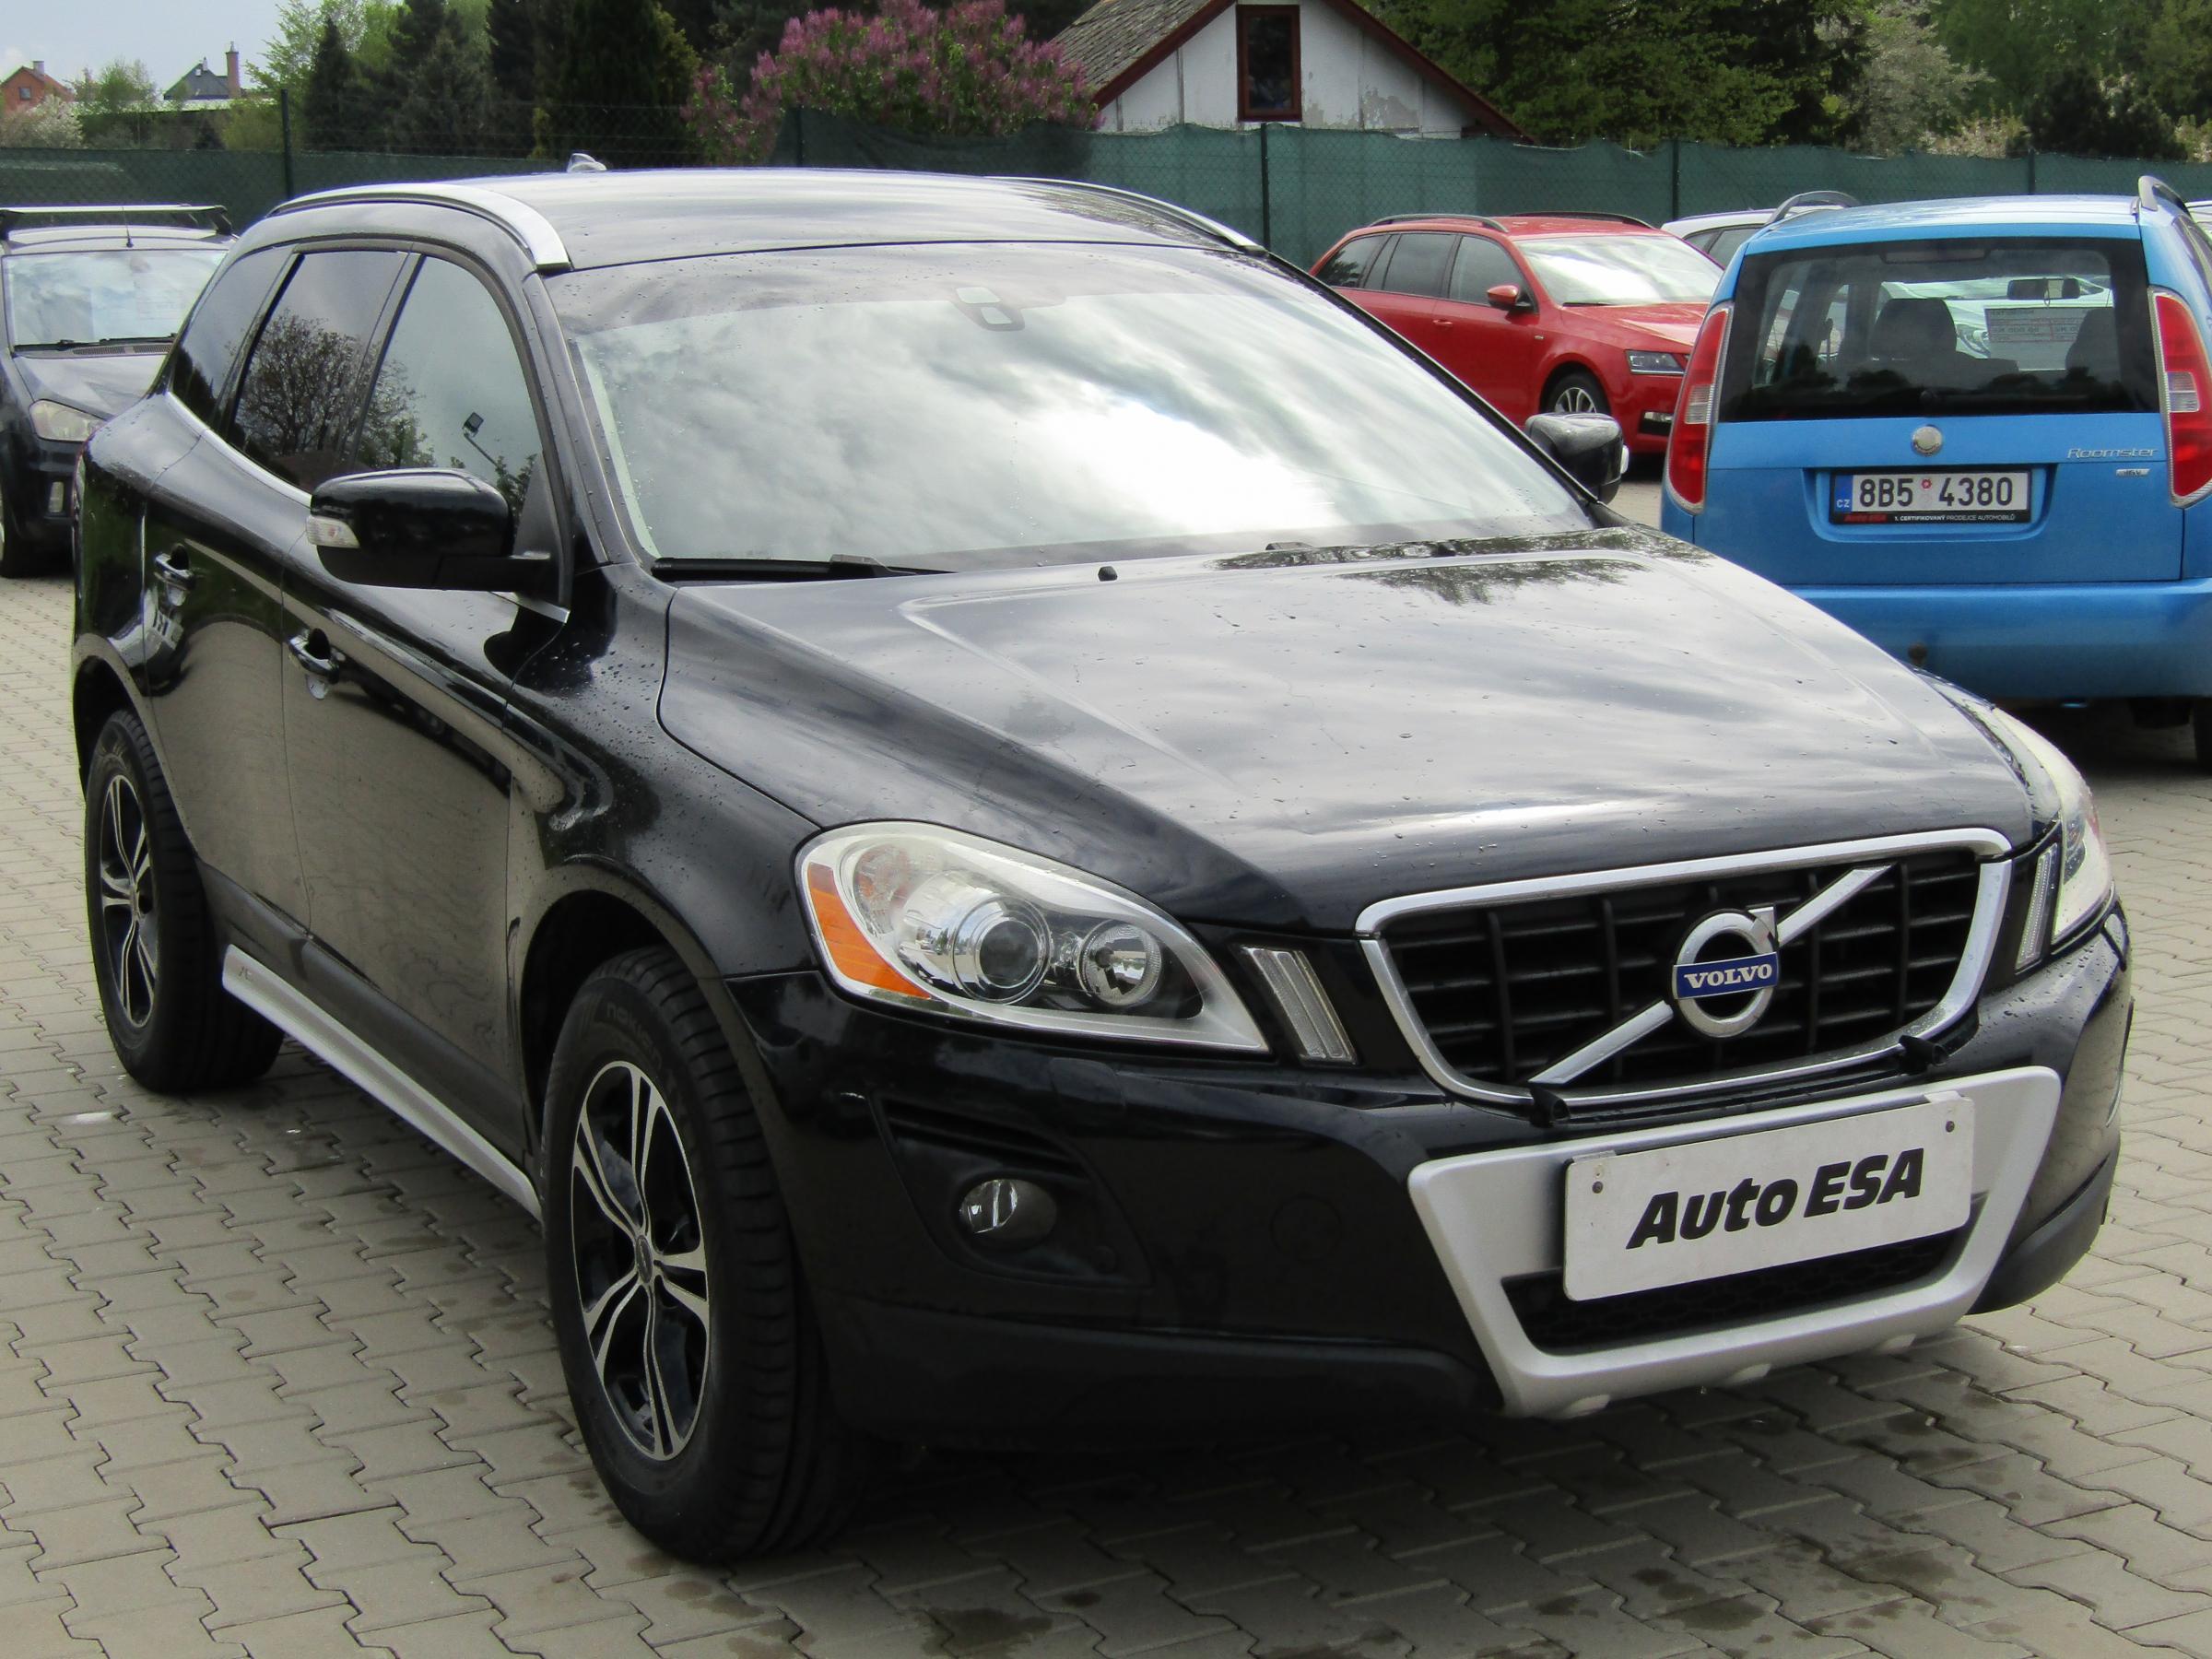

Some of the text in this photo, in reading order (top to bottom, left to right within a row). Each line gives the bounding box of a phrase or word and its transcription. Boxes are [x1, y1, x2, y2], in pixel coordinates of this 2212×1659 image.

[2066, 447, 2158, 459] Roomster
[1836, 499, 1850, 508] CZ
[1860, 477, 2013, 507] 8B5 4380
[1684, 963, 1772, 989] VOLVO
[1625, 1147, 1924, 1250] Auto ESA
